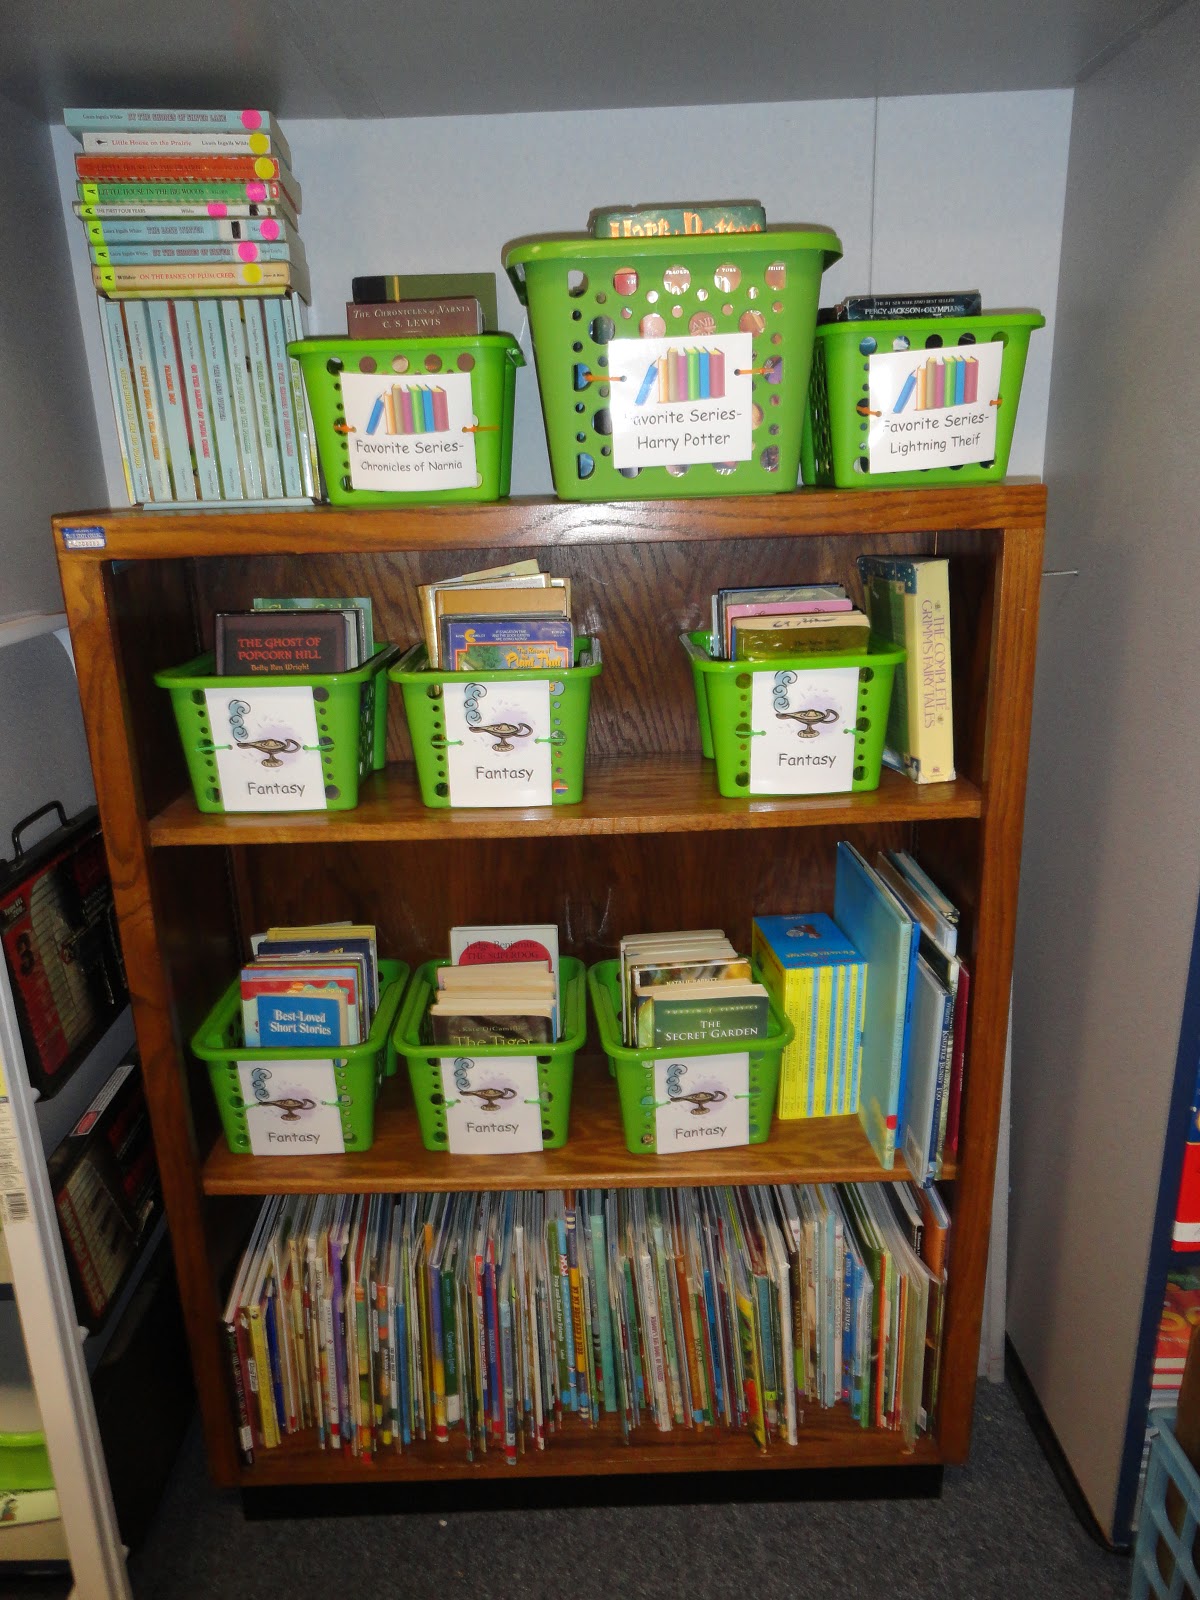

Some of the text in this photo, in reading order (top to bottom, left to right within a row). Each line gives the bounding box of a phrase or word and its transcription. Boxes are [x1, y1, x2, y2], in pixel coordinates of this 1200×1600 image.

[353, 309, 370, 319] THE
[374, 307, 428, 318] CHRONICLES
[436, 305, 471, 315] NARNIA
[923, 305, 965, 313] OLYMPIANS
[382, 318, 441, 329] C. S. LEWIS
[690, 409, 742, 423] Series-
[944, 413, 990, 427] Series-
[356, 439, 464, 454] Favorite Series-
[637, 432, 731, 451] Harry Potter
[890, 433, 981, 457] Lightning Theif
[360, 460, 463, 472] Chronicles of Narnia
[237, 636, 322, 648] THE GHOST OF
[237, 649, 322, 661] POPCORN HILL
[505, 650, 562, 668] Plant That
[285, 663, 310, 672] Wright
[933, 615, 947, 712] THE COMPLETE
[923, 656, 934, 689] FAIRY
[923, 690, 935, 729] TALES
[778, 753, 837, 768] Fantasy
[475, 765, 534, 782] Fantasy
[247, 781, 306, 797] Fantasy
[274, 1008, 326, 1024] Best-Loved
[270, 1022, 331, 1035] Short Stories
[700, 1020, 721, 1029] THE
[453, 1035, 533, 1046] The Tiger
[665, 1027, 758, 1041] SECRET GARDEN
[937, 1062, 946, 1084] BUNNY
[466, 1122, 520, 1134] Fantasy
[675, 1125, 728, 1139] Fantasy
[268, 1131, 320, 1144] Fantasy
